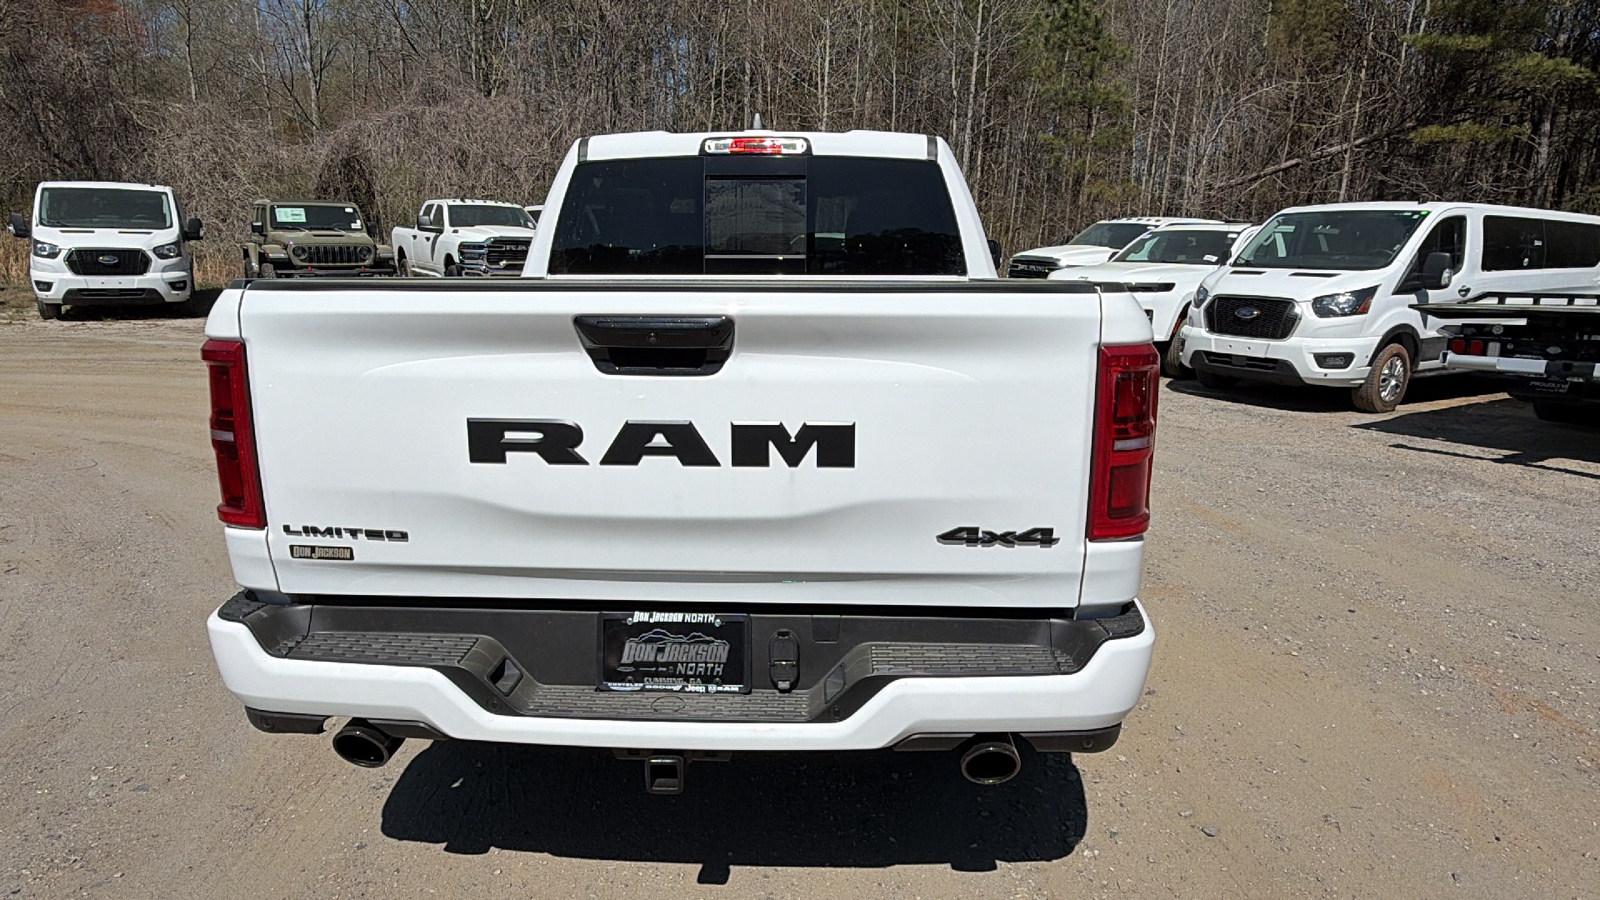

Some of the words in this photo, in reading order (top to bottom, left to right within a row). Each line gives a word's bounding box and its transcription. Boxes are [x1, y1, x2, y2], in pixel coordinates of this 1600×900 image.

[466, 417, 856, 468] RAM
[282, 524, 409, 542] LIMITED
[936, 526, 1061, 548] 4x4
[684, 613, 716, 623] NORTH
[676, 663, 724, 675] NORTH
[685, 684, 706, 693] Jeep
